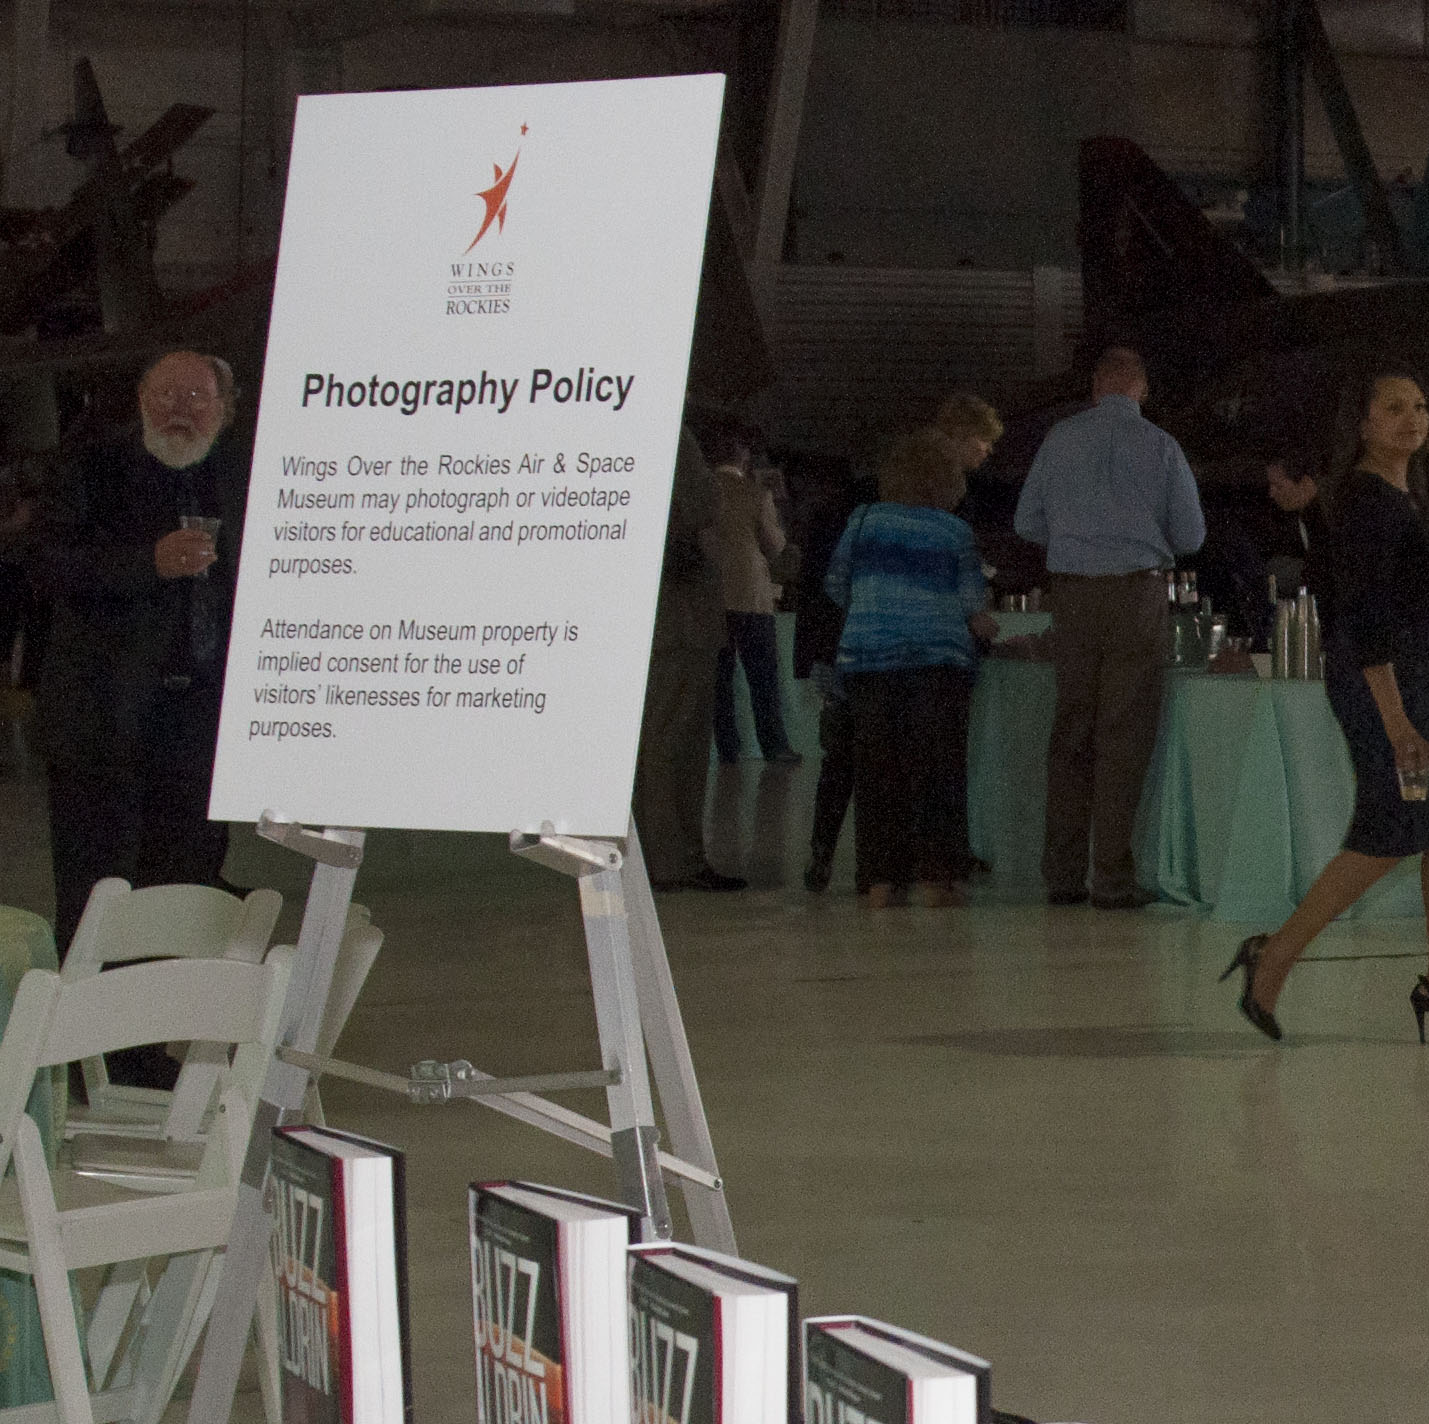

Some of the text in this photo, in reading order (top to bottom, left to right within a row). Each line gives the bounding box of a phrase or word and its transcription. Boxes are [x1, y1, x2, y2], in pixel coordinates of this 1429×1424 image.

[451, 262, 515, 277] WINGS
[447, 283, 511, 295] OVER THE
[446, 299, 511, 315] ROCKIES
[301, 367, 636, 416] Photography Policy
[282, 452, 635, 481] Wings Over the Rockies Air & Space
[277, 486, 631, 515] Museum may photograph or videotape
[274, 518, 627, 546] visitors for educational and promotional
[268, 555, 358, 578] purposes.
[260, 618, 578, 647] Attendance on Museum property is
[257, 650, 527, 676] implied consent for the use of
[325, 684, 420, 707] likenesses
[426, 686, 452, 707] for
[455, 687, 546, 714] marketing
[249, 718, 337, 741] purposes.
[268, 1175, 328, 1305] BUZZ
[473, 1237, 546, 1379] BUZZ
